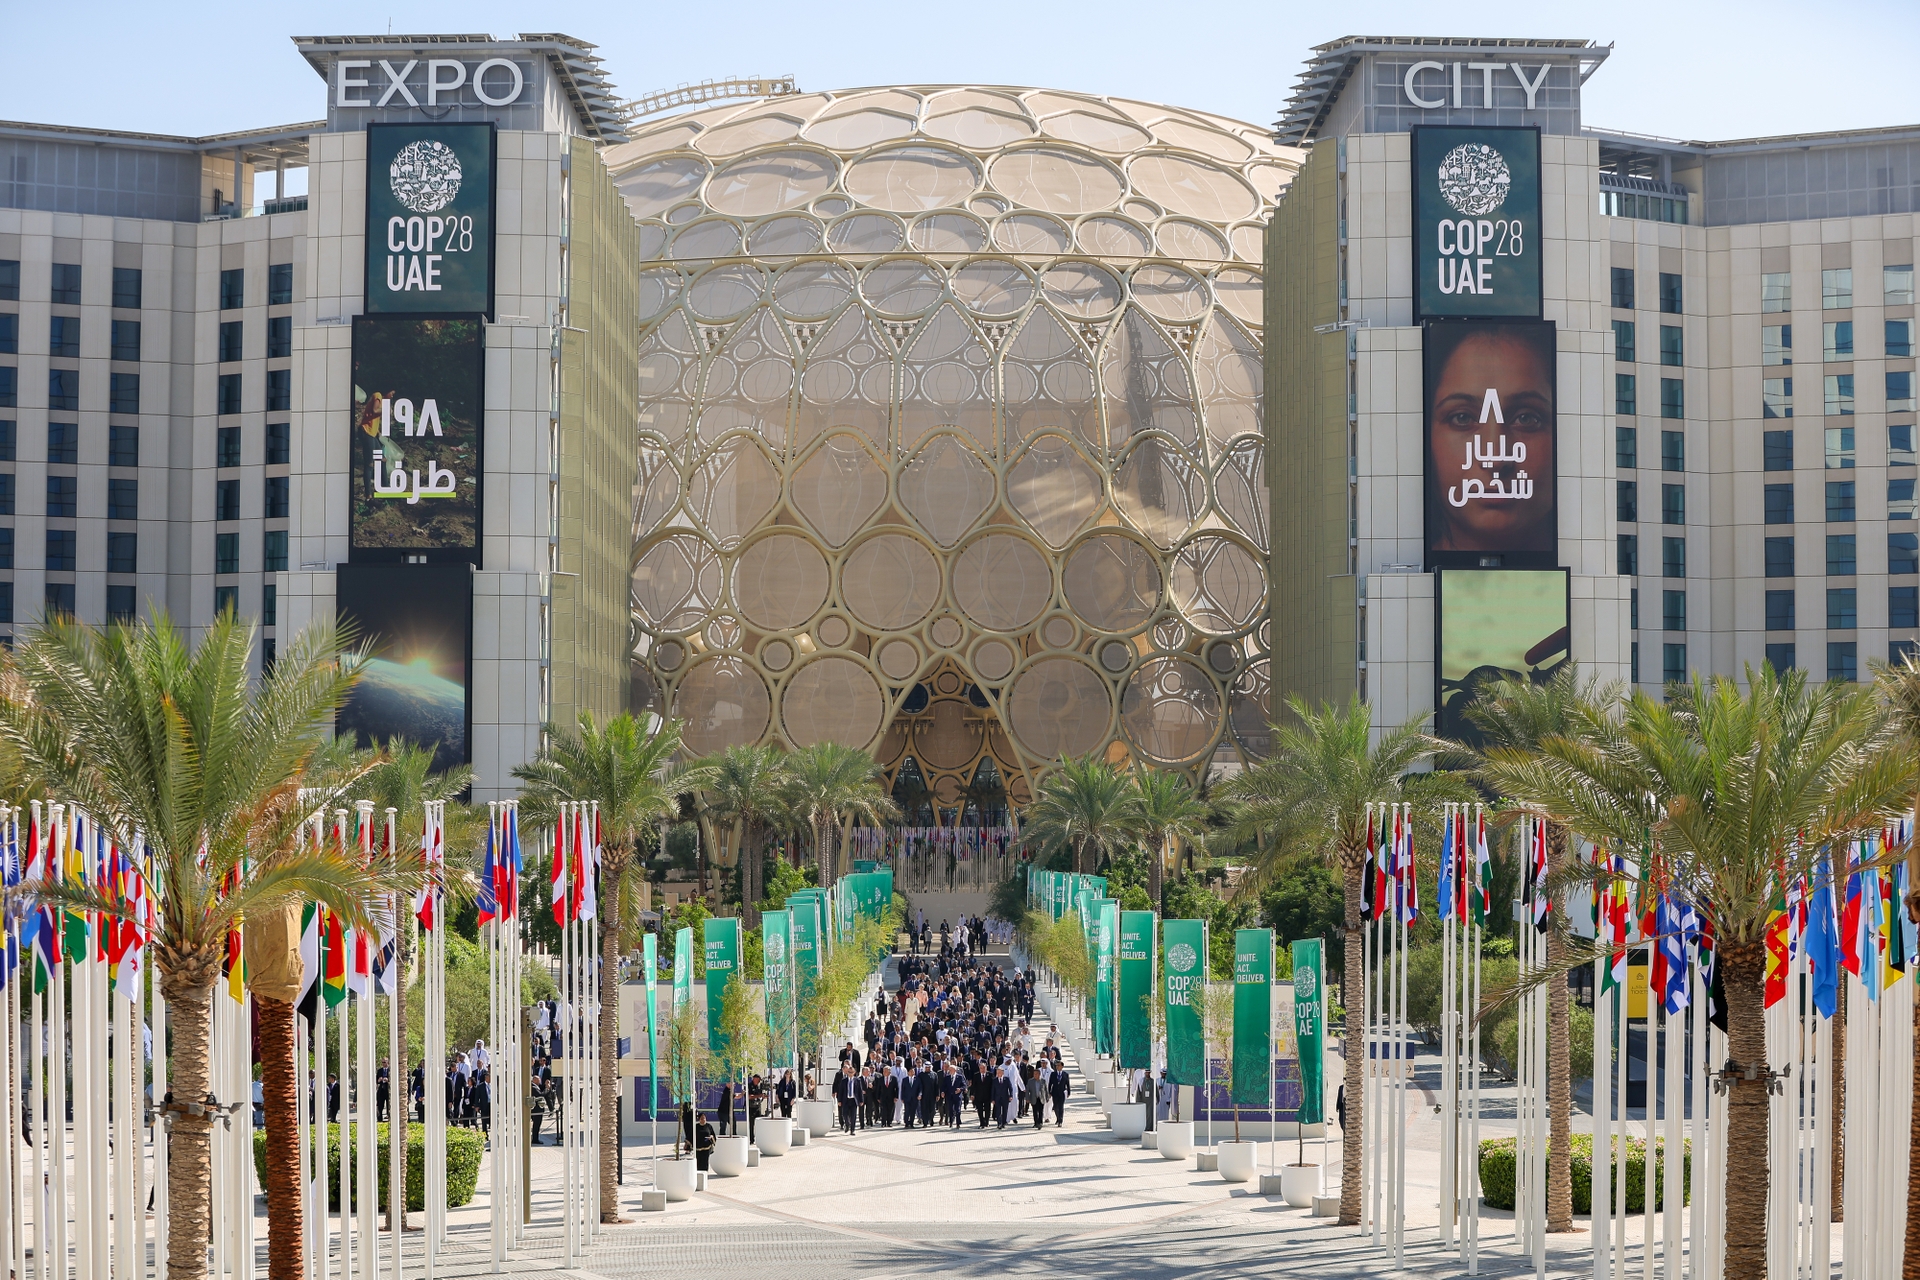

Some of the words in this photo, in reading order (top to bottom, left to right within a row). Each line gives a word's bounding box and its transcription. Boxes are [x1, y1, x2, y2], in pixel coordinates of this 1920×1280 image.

[336, 58, 523, 107] EXPO
[1404, 61, 1551, 110] CITY
[387, 215, 473, 252] COP28
[1438, 219, 1523, 256] COP28
[386, 255, 442, 291] UAE
[1438, 258, 1493, 294] UAE
[1479, 388, 1504, 423] ٨
[381, 398, 443, 436] ١٩٨
[1462, 434, 1527, 470] مليار
[1448, 469, 1533, 508] شخص
[1122, 932, 1141, 941] UNITE.
[706, 941, 726, 950] UNITE.
[1121, 941, 1135, 950] ACT.
[706, 951, 719, 959] ACT.
[1121, 951, 1148, 959] DELIVER.
[1237, 953, 1258, 962] UNITE.
[706, 960, 733, 969] DELIVER.
[1236, 963, 1251, 972] ACT.
[1168, 975, 1202, 991] COP28
[1236, 974, 1266, 983] DELIVER.
[1168, 991, 1190, 1006] UAE
[1298, 1018, 1314, 1036] AE
